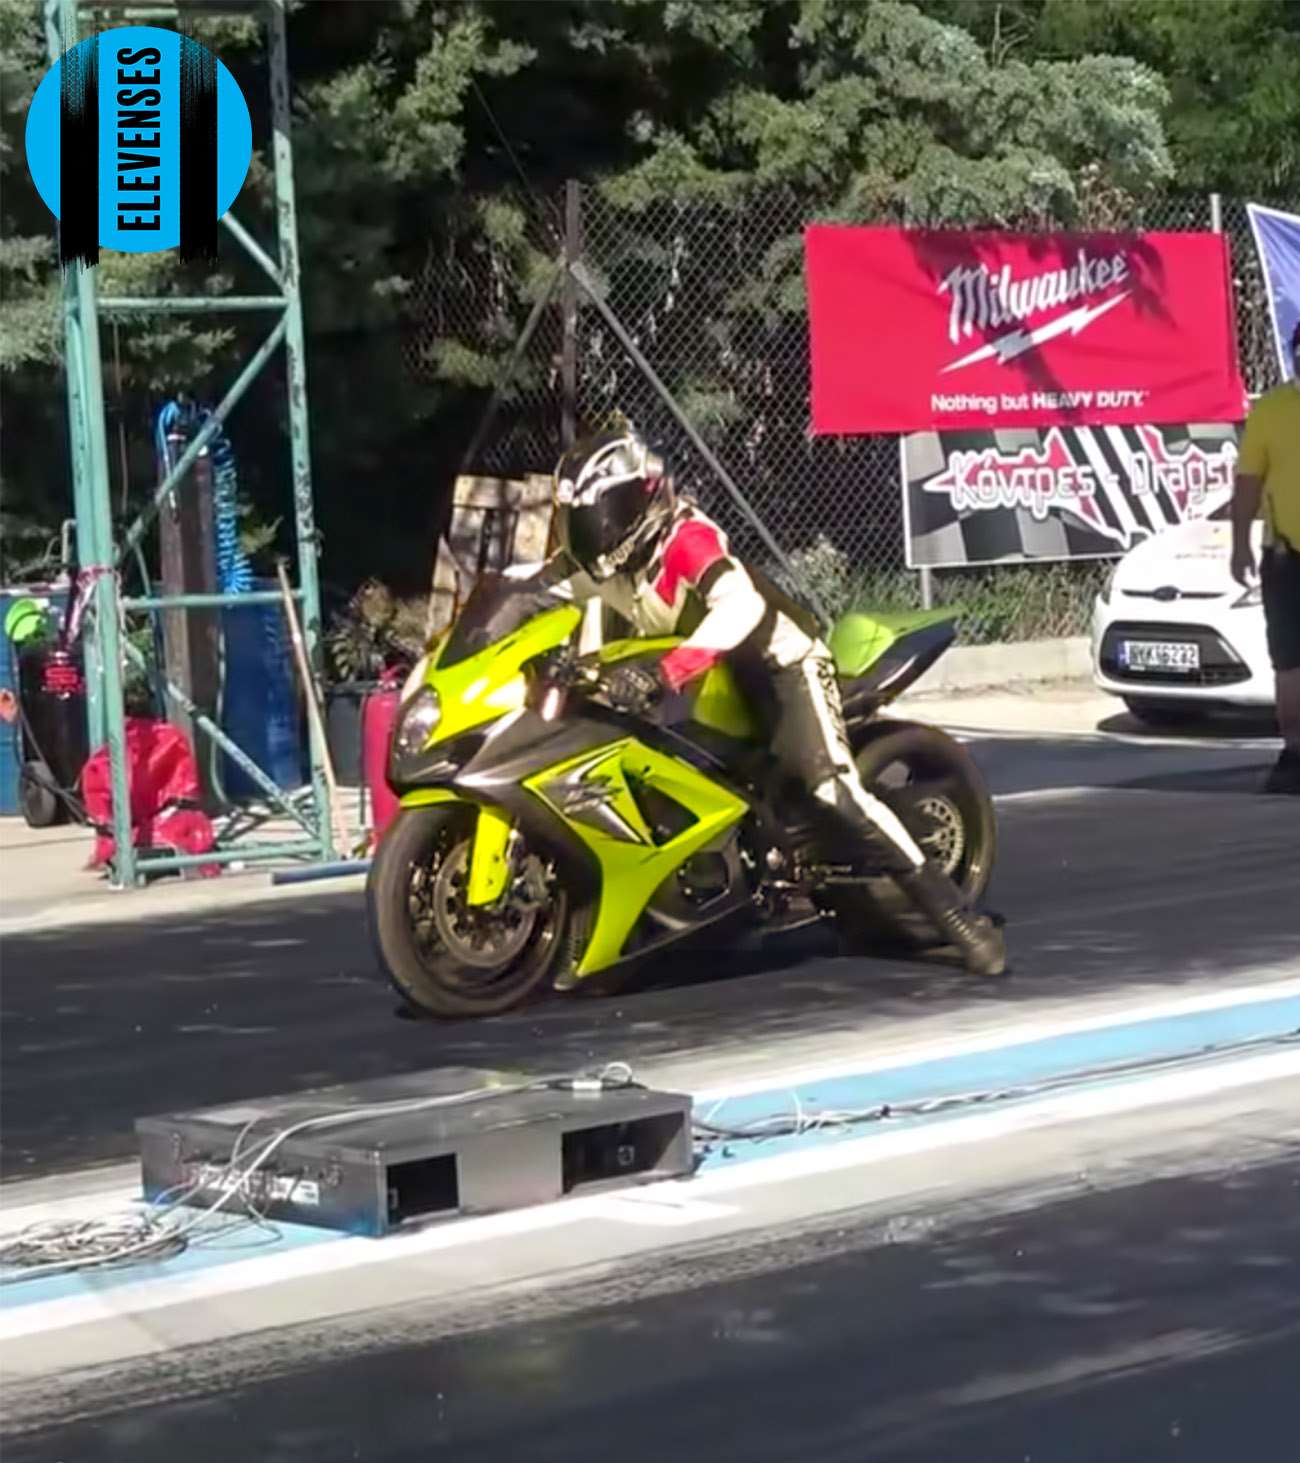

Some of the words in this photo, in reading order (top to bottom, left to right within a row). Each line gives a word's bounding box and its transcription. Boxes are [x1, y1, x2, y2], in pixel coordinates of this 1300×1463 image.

[937, 248, 1129, 345] Milwaukee
[931, 393, 998, 415] Nothing
[1001, 392, 1030, 411] but
[1032, 391, 1093, 410] HEAVY
